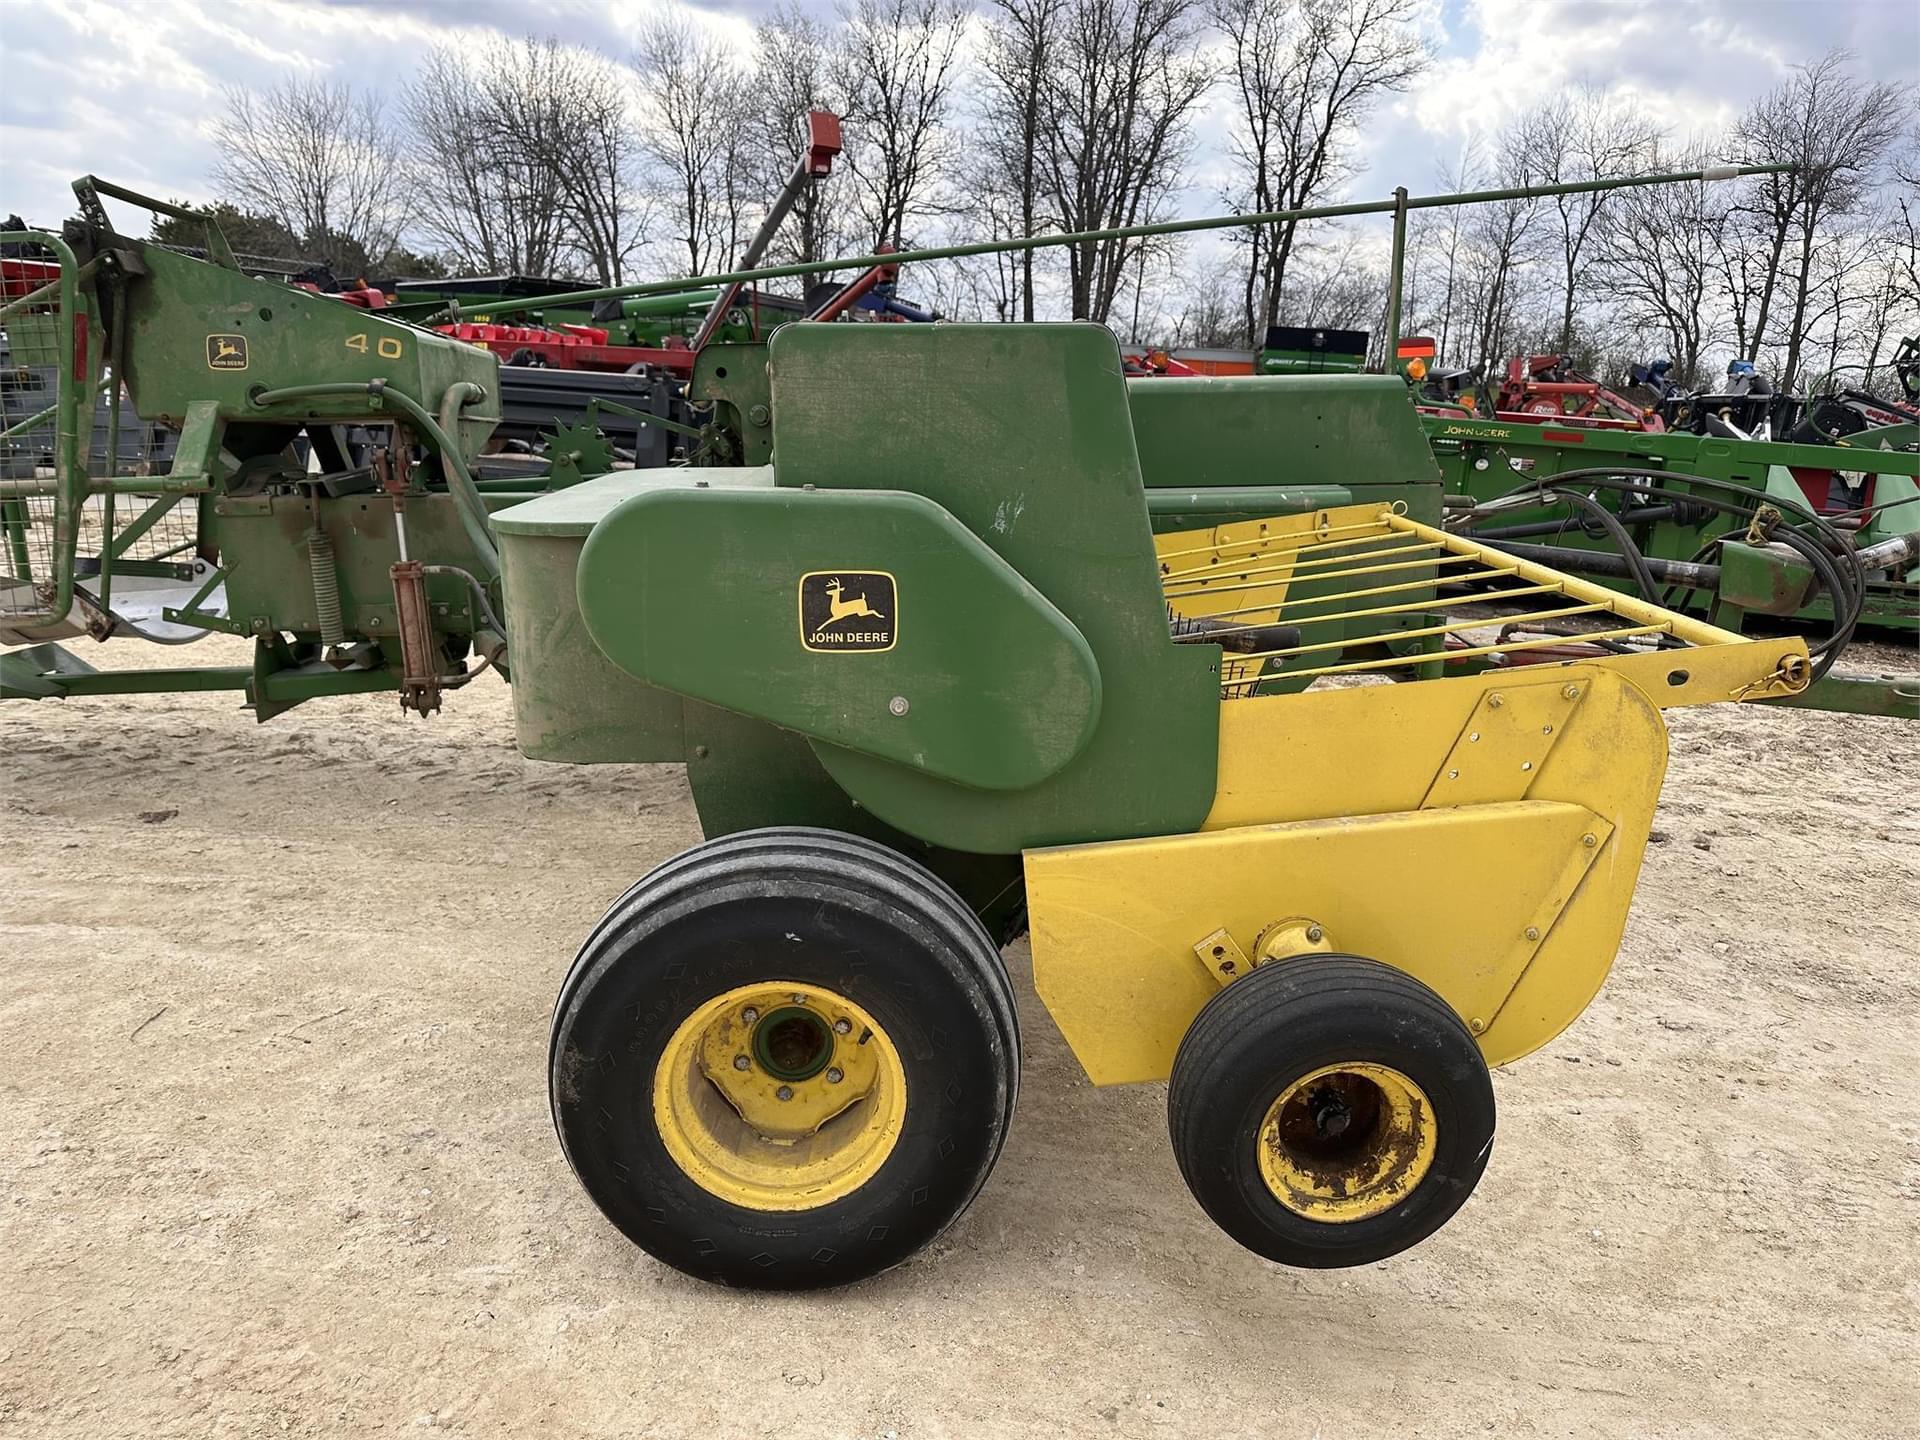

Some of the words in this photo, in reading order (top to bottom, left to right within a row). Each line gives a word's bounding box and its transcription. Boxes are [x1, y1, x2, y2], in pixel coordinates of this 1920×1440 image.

[1443, 425, 1474, 436] JOHN
[809, 632, 844, 643] JOHN
[847, 632, 889, 643] DEERE
